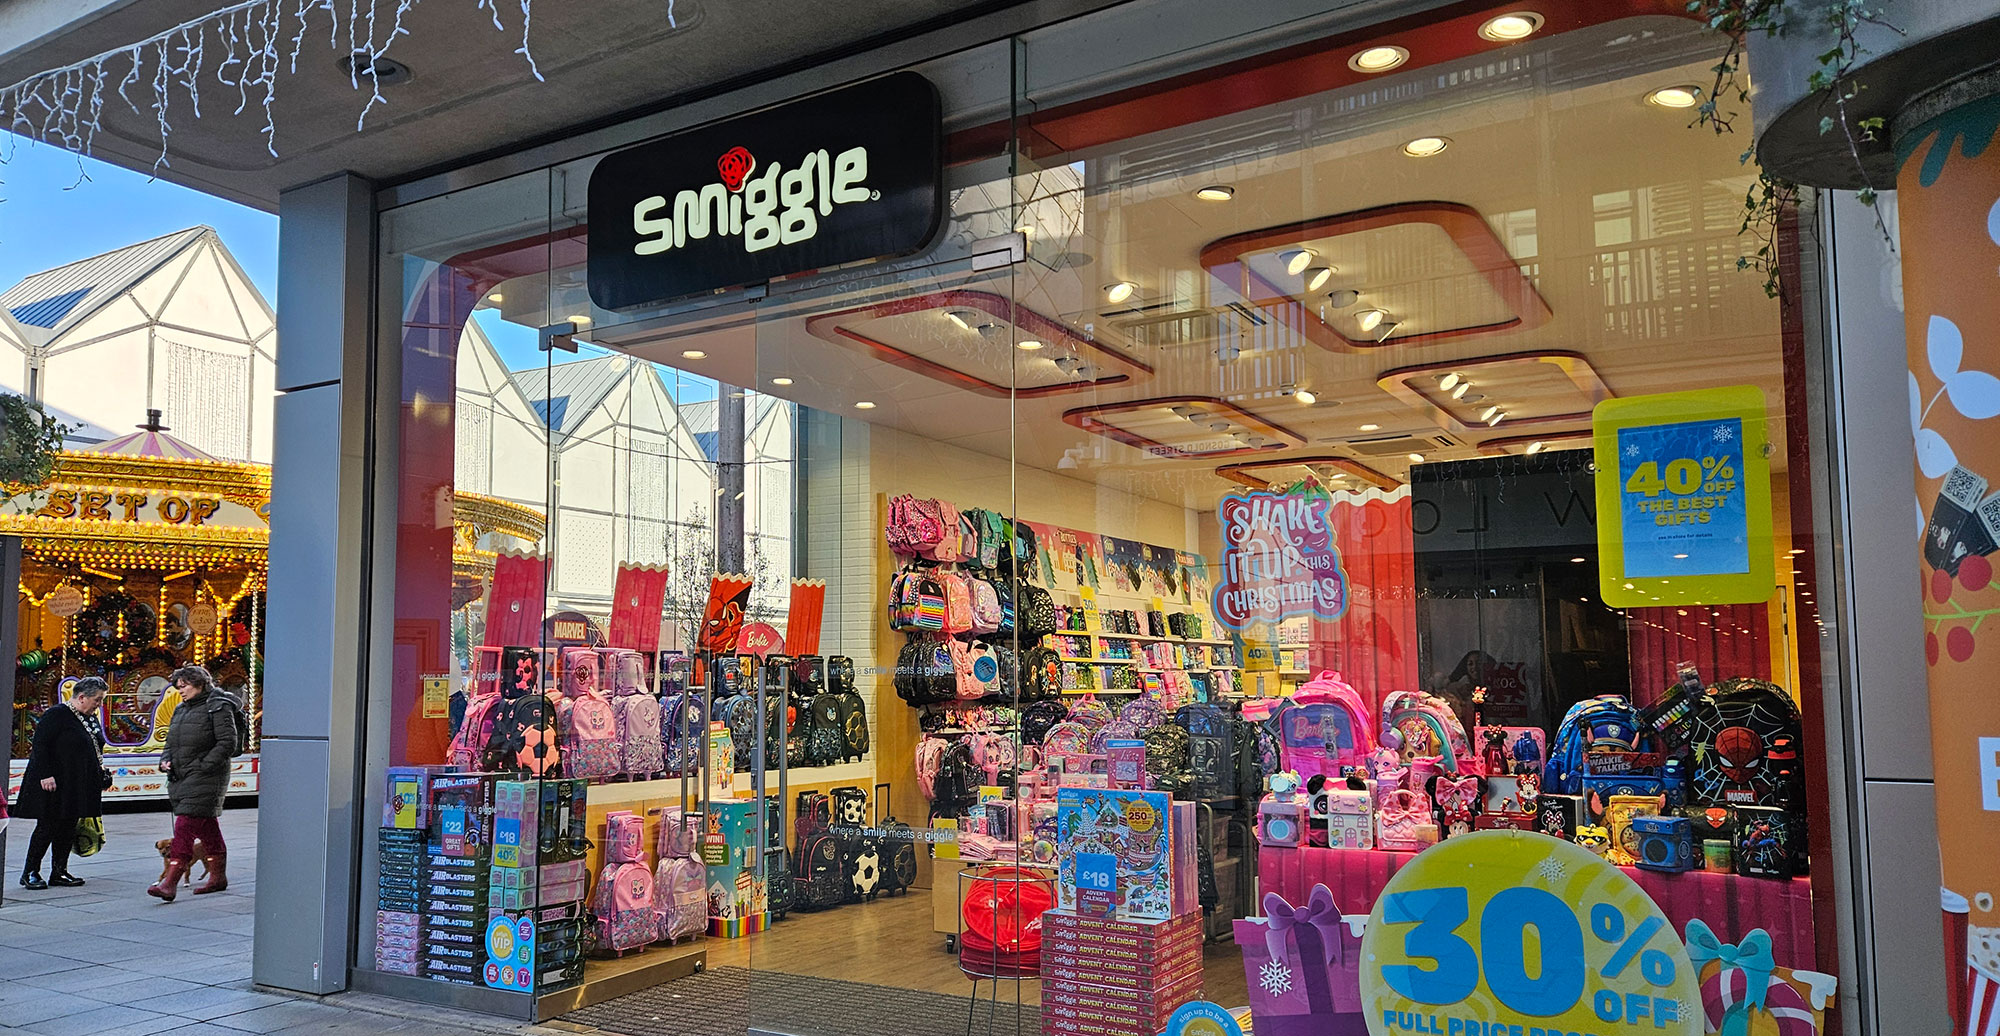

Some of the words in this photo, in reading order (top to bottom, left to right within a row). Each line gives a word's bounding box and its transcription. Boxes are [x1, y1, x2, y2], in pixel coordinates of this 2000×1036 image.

[1626, 455, 1735, 497] 40%
[1703, 481, 1736, 494] OFF
[35, 489, 148, 522] SET
[156, 496, 221, 526] OF
[1637, 501, 1674, 513] THE
[1678, 496, 1728, 511] BEST
[1230, 498, 1324, 547] SHAKE
[1655, 511, 1711, 526] GIFTS
[1229, 550, 1255, 584] IT
[1247, 538, 1300, 580] UP
[1302, 554, 1331, 570] THIS
[1222, 577, 1338, 620] CHRISTMAS
[554, 621, 586, 639] MARVEL
[747, 631, 769, 648] Barbie
[1590, 756, 1623, 766] WALKIE
[1596, 763, 1632, 773] TALKIES
[1726, 792, 1755, 802] MARVEL
[1128, 812, 1147, 820] 250
[445, 821, 461, 833] £22
[500, 831, 516, 844] £18
[829, 826, 853, 835] where
[863, 828, 887, 837] smile
[888, 830, 915, 839] meets
[925, 831, 954, 842] giggle
[497, 850, 517, 861] 40%
[1082, 870, 1110, 888] £18
[1082, 895, 1110, 903] CALENDAR
[1080, 920, 1104, 929] ADVENT
[1106, 923, 1138, 932] CALENDAR
[493, 937, 511, 949] VIP
[1079, 933, 1104, 942] ADVENT
[1105, 936, 1137, 945] CALENDAR
[1079, 946, 1104, 955] ADVENT
[1106, 949, 1138, 959] CALENDAR
[1381, 886, 1676, 1018] 30%
[1078, 959, 1102, 968] ADVENT
[1104, 962, 1136, 972] CALENDAR
[1078, 972, 1103, 981] ADVENT
[1104, 976, 1137, 985] CALENDAR
[1080, 985, 1104, 994] ADVENT
[1106, 989, 1138, 998] CALENDAR
[1079, 999, 1104, 1007] ADVENT
[1105, 1002, 1137, 1011] CALENDAR
[1594, 989, 1680, 1029] OFF
[1079, 1011, 1103, 1020] ADVENT
[1105, 1015, 1137, 1025] CALENDAR
[1180, 1011, 1193, 1022] sign
[1214, 1013, 1224, 1022] be
[1383, 1009, 1444, 1036] FULL
[1448, 1017, 1524, 1036] PRICE
[1080, 1024, 1104, 1033] ADVENT
